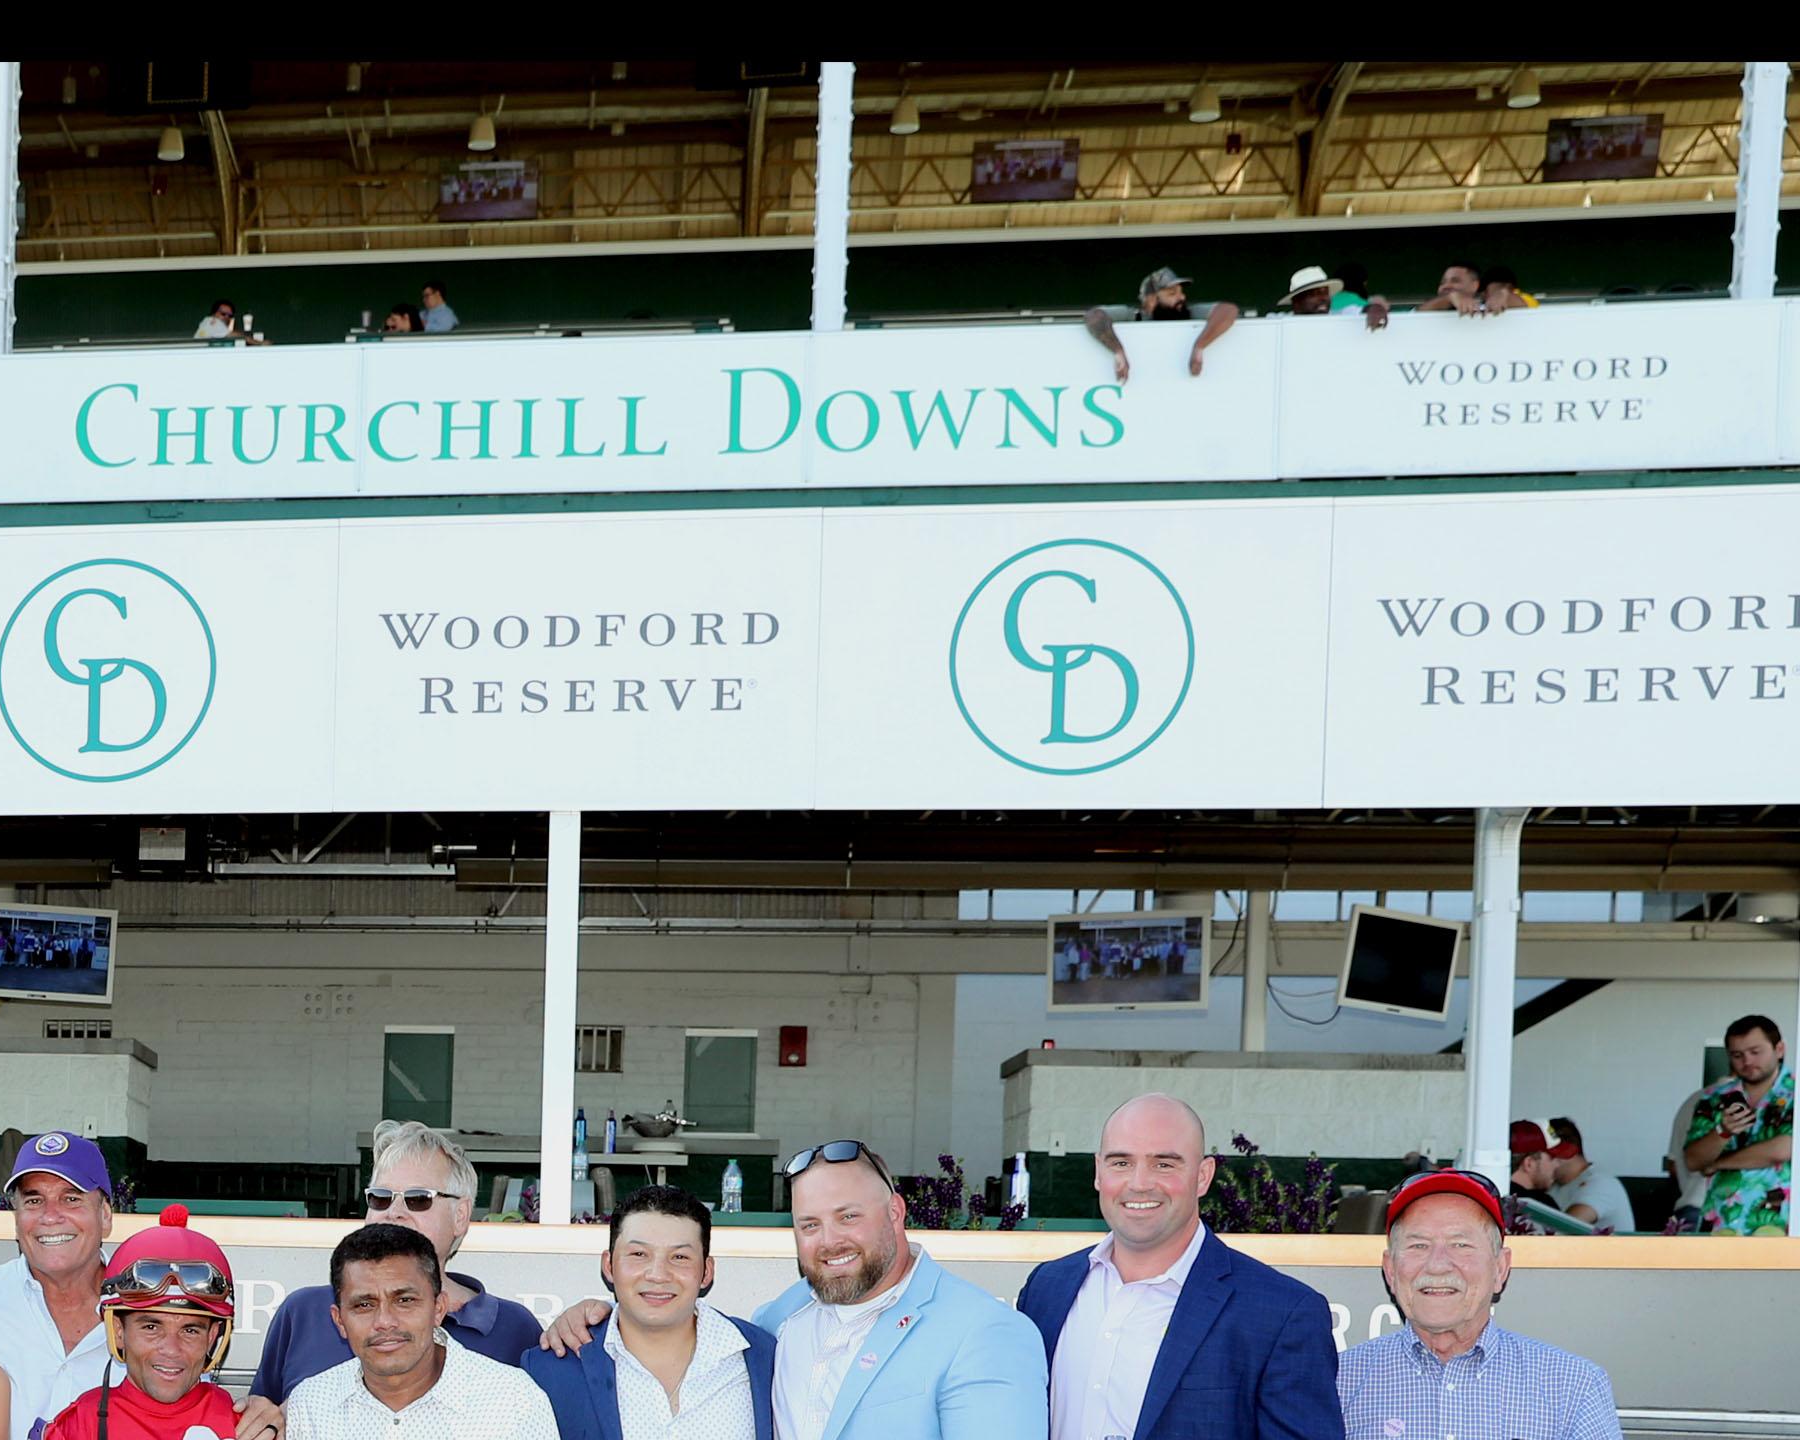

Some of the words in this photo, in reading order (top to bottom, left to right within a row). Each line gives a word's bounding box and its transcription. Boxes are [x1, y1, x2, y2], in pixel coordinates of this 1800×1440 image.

[1397, 356, 1668, 385] WOODFORD
[75, 383, 668, 468] CHURCHILL
[718, 367, 1125, 454] DOWNS
[1423, 399, 1643, 426] RESERVE
[379, 612, 780, 650] WOODFORD
[418, 677, 744, 714] RESERVE
[1420, 664, 1788, 705] RESERVE
